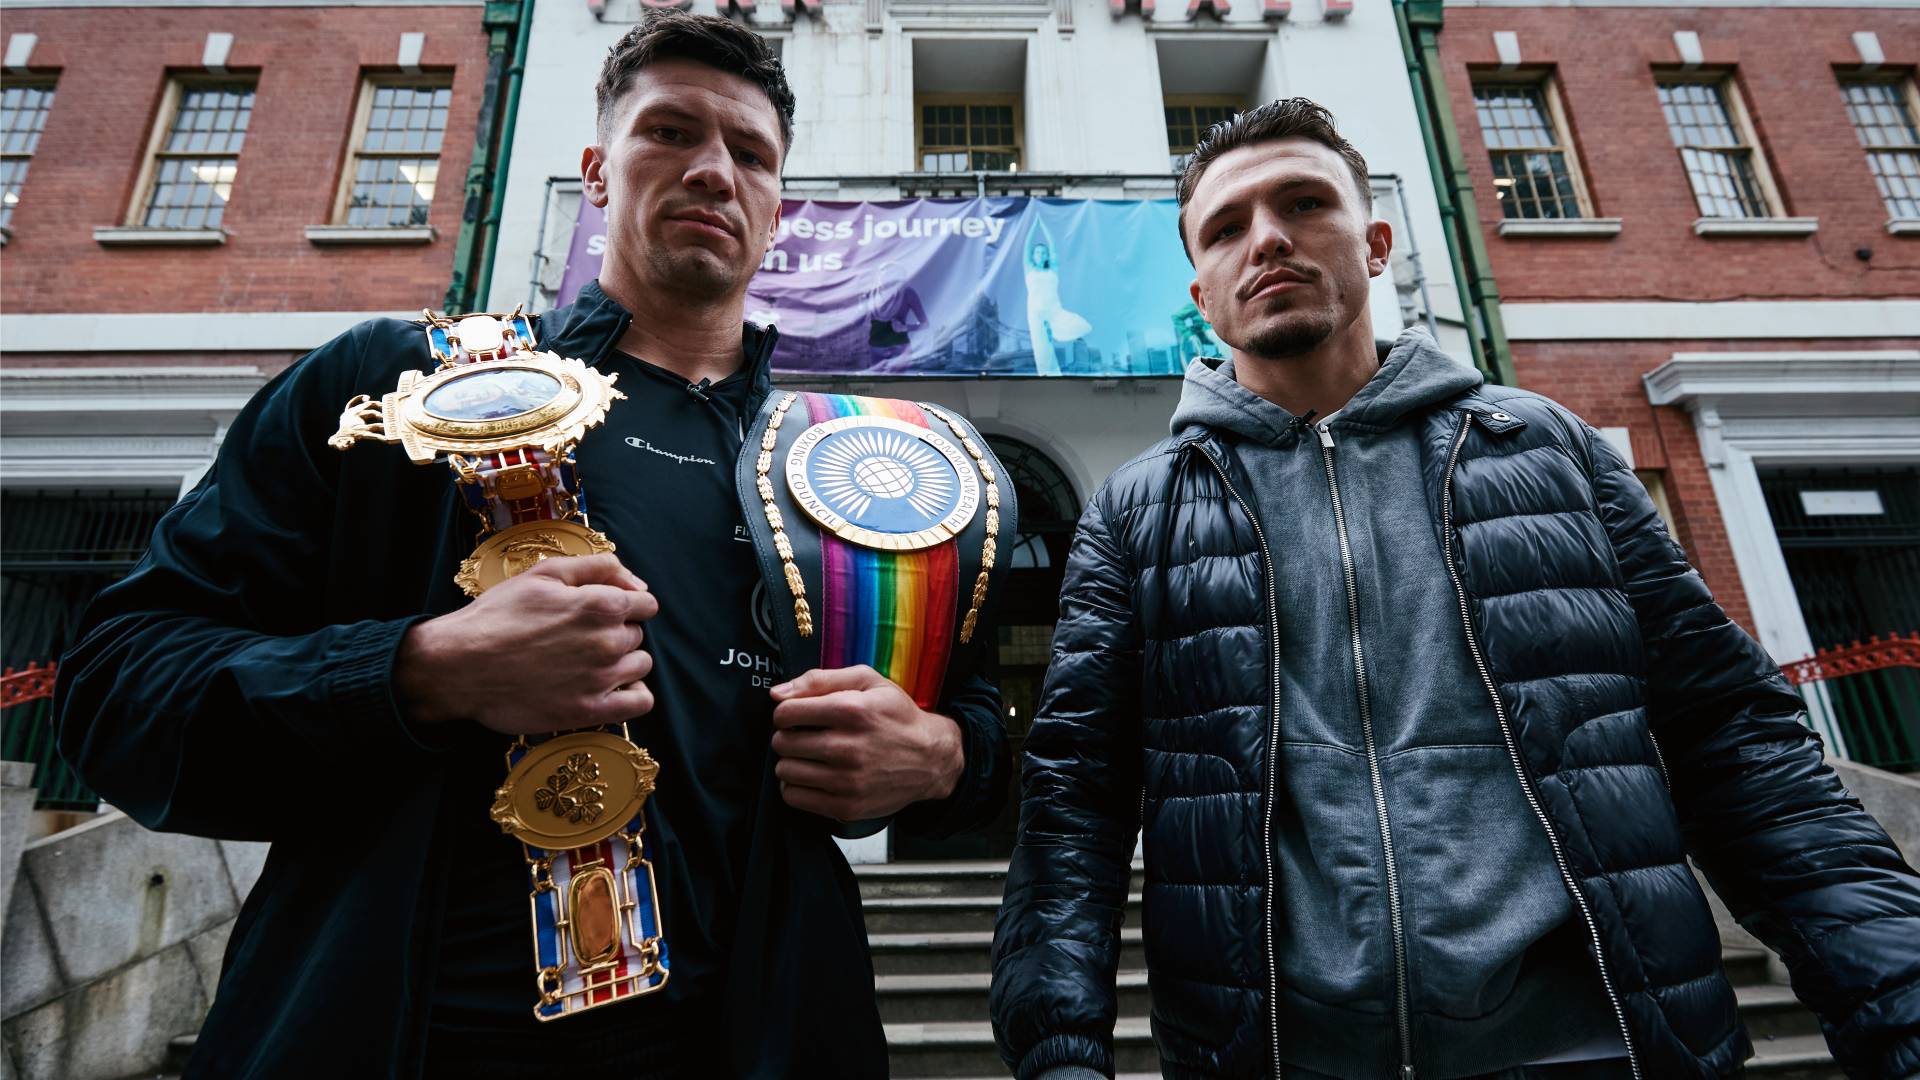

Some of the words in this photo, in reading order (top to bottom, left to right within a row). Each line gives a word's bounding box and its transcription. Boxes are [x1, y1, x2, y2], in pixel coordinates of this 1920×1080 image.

[857, 213, 1006, 246] journey
[798, 252, 843, 273] us
[624, 436, 716, 465] Champion
[790, 426, 826, 466] BOXING
[925, 433, 976, 528] COMMONWEALTH
[791, 473, 837, 527] COUNCIL
[735, 525, 749, 537] FI
